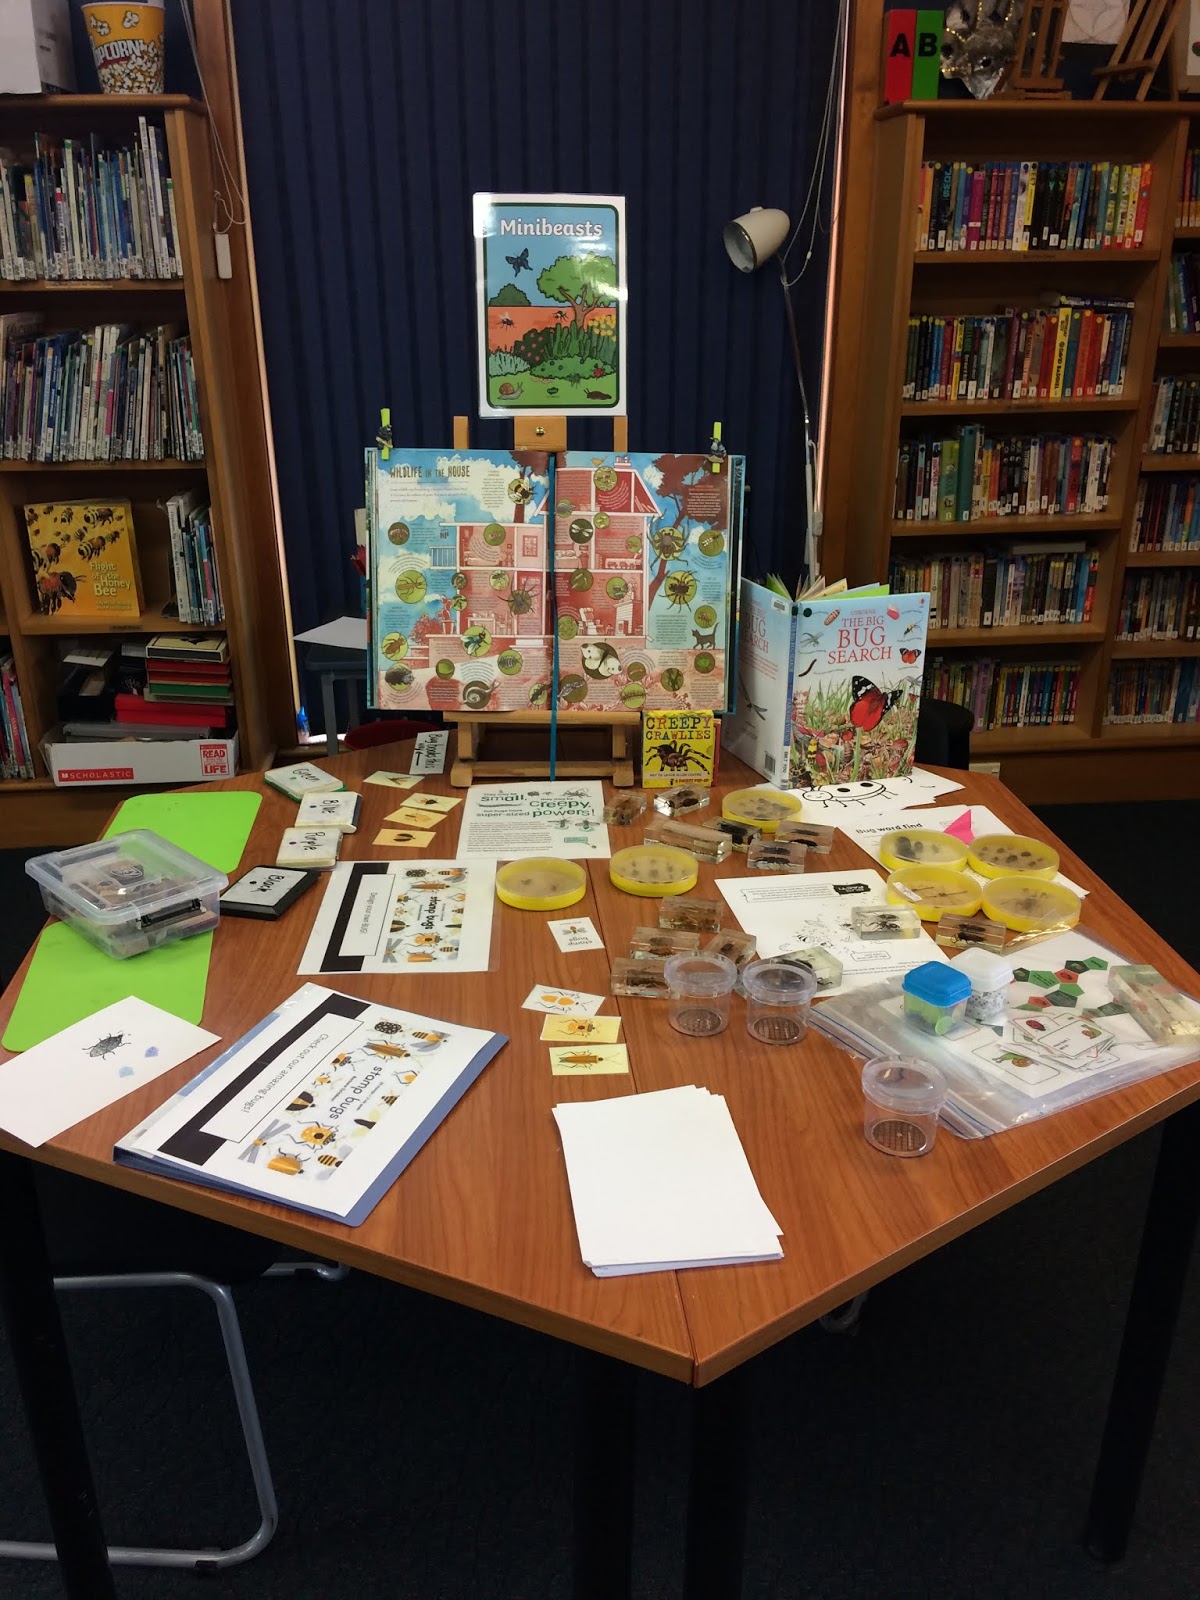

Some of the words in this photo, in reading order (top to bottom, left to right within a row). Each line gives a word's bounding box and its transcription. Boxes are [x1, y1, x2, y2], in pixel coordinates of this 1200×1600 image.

[890, 33, 910, 57] A
[918, 32, 938, 56] B
[500, 218, 603, 237] Minibeasts
[390, 466, 422, 478] WILDLIFE
[435, 469, 444, 478] THE
[448, 466, 470, 478] HOUSE
[90, 561, 116, 573] Flight
[94, 583, 117, 596] Bee
[100, 574, 130, 590] Honey
[842, 618, 864, 628] THE
[866, 616, 884, 626] BIG
[838, 626, 886, 648] BUG
[828, 646, 892, 664] SEARCH
[646, 714, 712, 730] CREEPY
[646, 730, 710, 740] CRAWLIES
[202, 750, 226, 758] READ
[69, 770, 131, 780] SCHOLASTIC
[204, 765, 227, 774] LIFE
[292, 768, 320, 783] Green
[320, 799, 341, 814] Blue
[532, 809, 595, 817] powers!
[300, 832, 325, 850] Purple
[250, 874, 285, 892] Black
[424, 896, 441, 914] stamp
[421, 915, 439, 929] bugs
[309, 1034, 329, 1049] Check
[298, 1048, 310, 1059] out
[287, 1059, 299, 1070] our
[258, 1070, 288, 1095] amazing
[350, 1066, 382, 1094] stamp
[241, 1094, 264, 1113] bugs!
[330, 1097, 360, 1120] bugs
